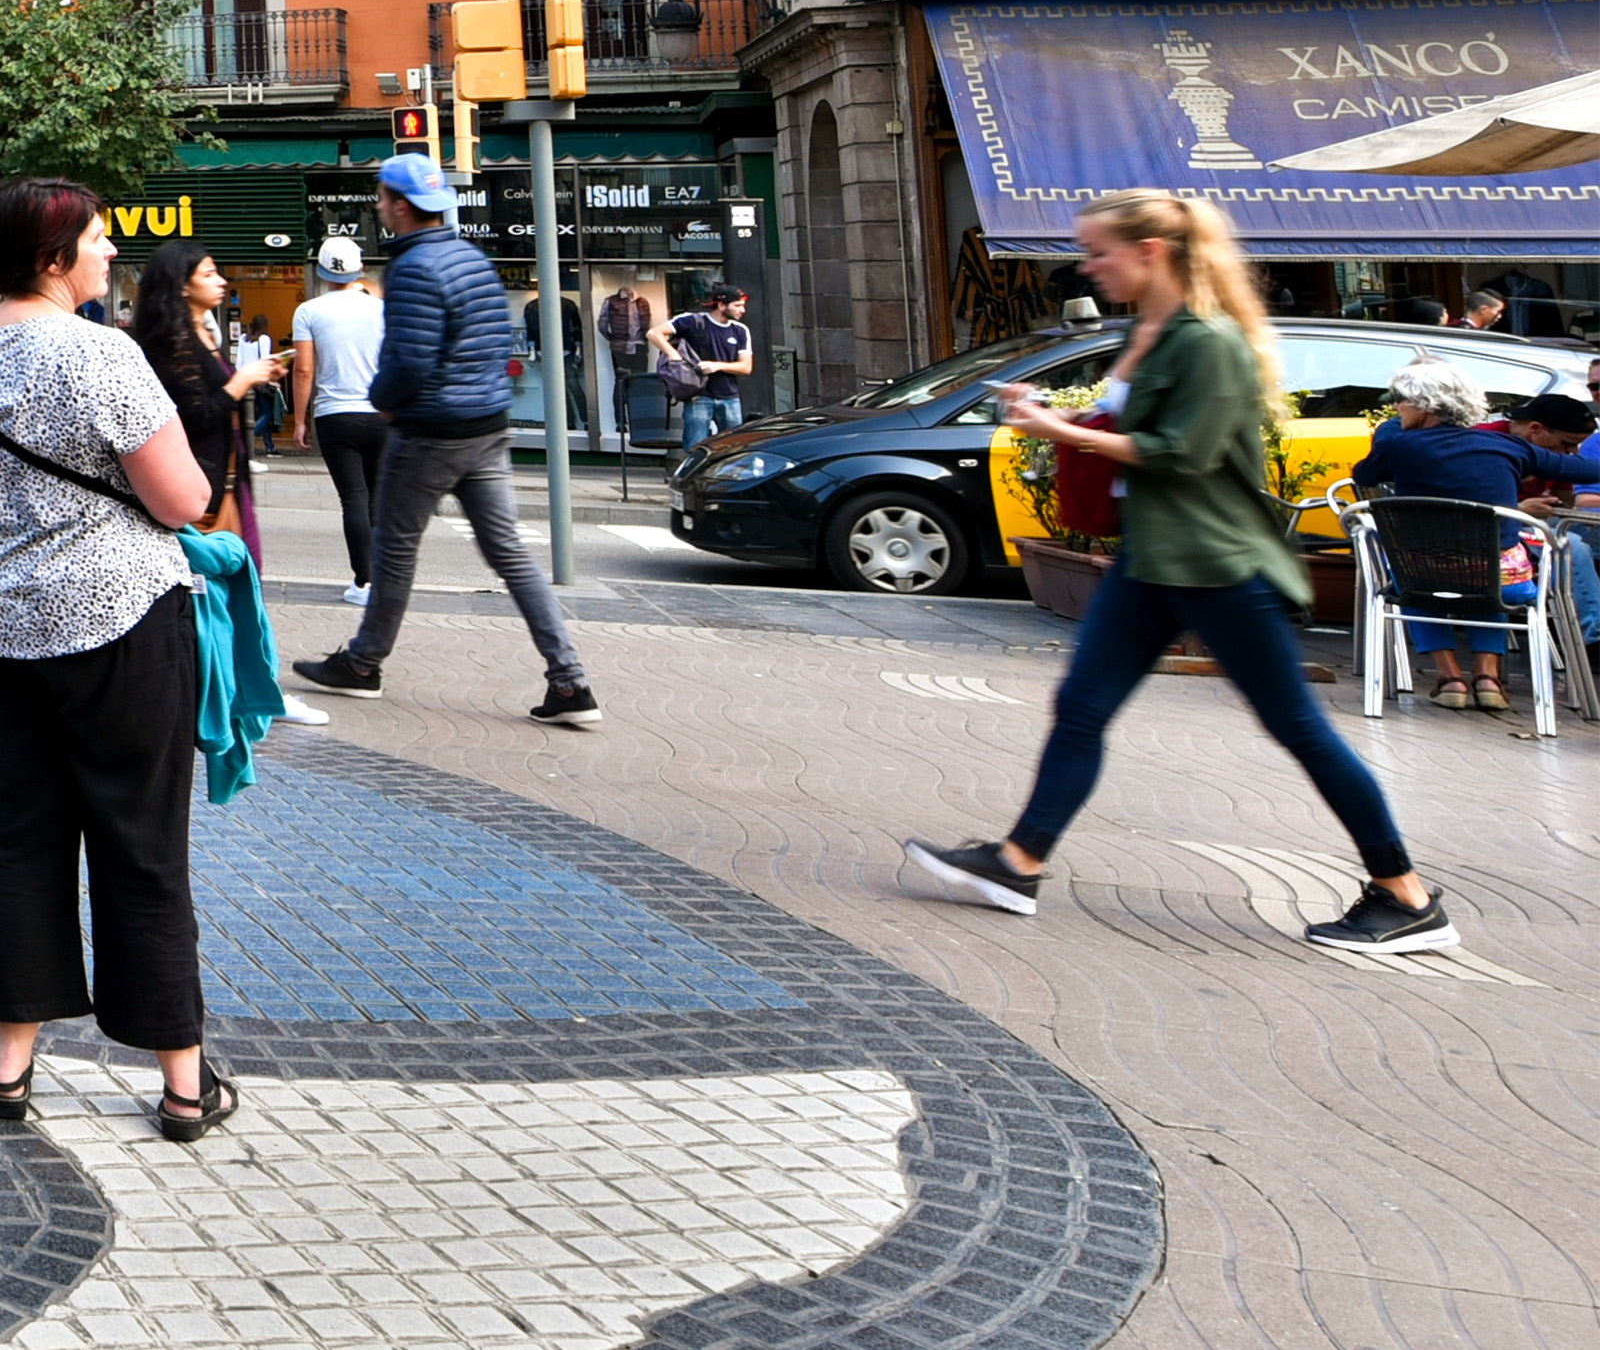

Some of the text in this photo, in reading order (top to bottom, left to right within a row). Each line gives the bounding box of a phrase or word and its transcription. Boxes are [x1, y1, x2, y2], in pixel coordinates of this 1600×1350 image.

[1276, 31, 1509, 80] XANCÓ
[1293, 94, 1511, 120] CAMISE
[457, 190, 487, 207] olid
[664, 186, 701, 199] EA7
[327, 223, 359, 236] EA7
[507, 224, 576, 236] GEX
[678, 232, 721, 240] LACOSTE
